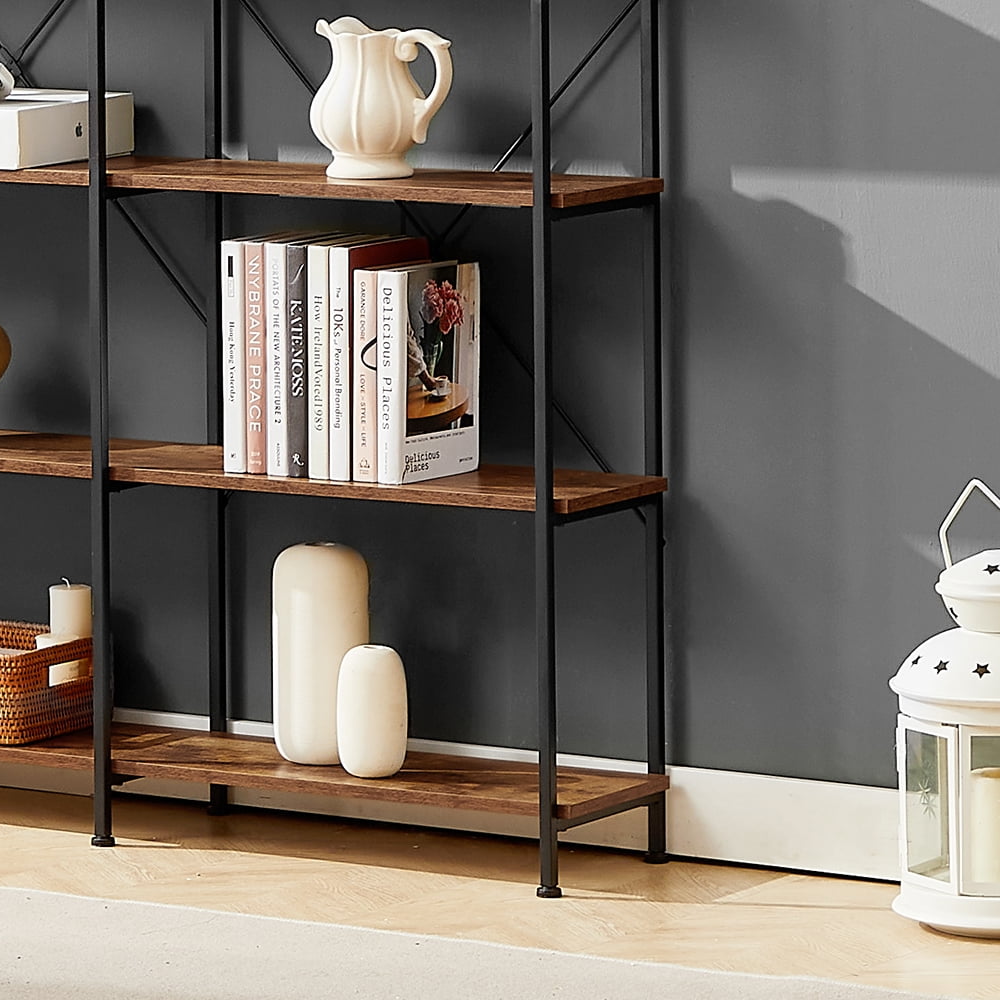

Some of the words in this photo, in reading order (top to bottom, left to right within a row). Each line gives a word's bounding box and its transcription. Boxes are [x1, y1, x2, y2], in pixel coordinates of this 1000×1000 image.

[248, 255, 261, 357] WYBRANE
[272, 297, 280, 309] OF
[313, 295, 323, 321] How
[272, 313, 281, 328] THE
[333, 307, 344, 338] 10Ks
[382, 287, 394, 368] Delicious
[228, 343, 236, 364] Kong
[273, 331, 281, 352] NEW
[334, 348, 343, 386] Personal
[228, 366, 236, 403] Yesterday
[248, 365, 262, 433] PRACE
[273, 354, 282, 415] ARCHITECTURE
[333, 388, 343, 430] Branding
[359, 402, 367, 423] STYLE
[381, 377, 393, 431] Places
[404, 451, 440, 465] Delicious
[405, 462, 430, 473] Places
